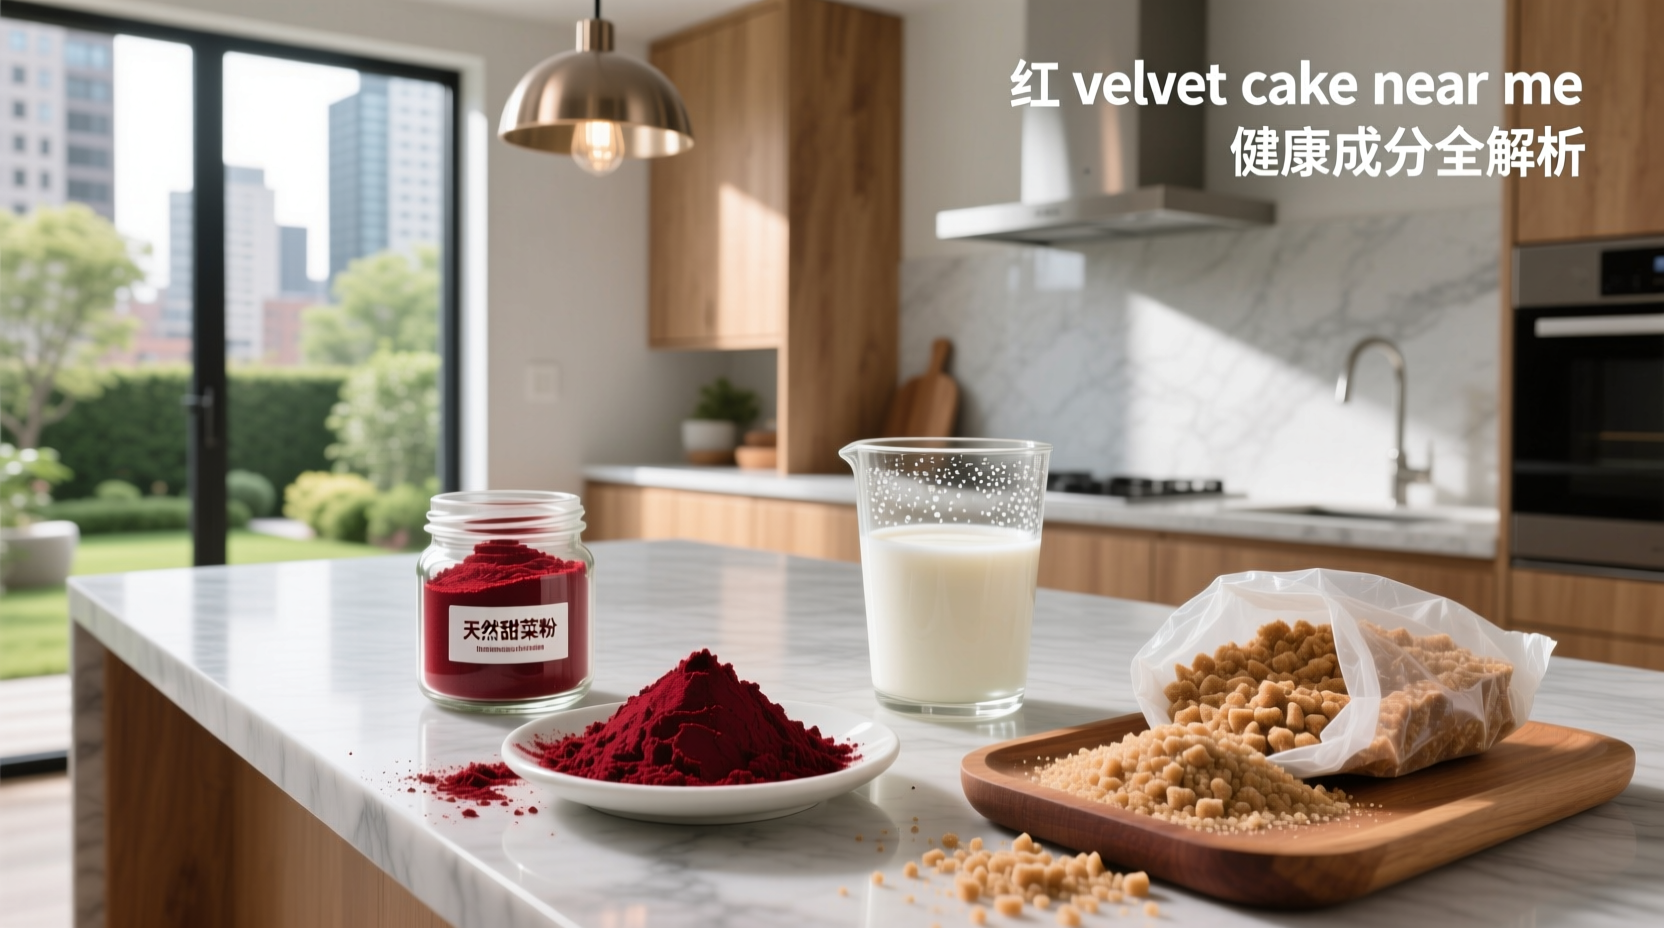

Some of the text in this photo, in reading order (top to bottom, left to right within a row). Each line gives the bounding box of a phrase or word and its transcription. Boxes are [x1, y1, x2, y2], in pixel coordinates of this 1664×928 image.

[463, 617, 557, 641] 天然甜菜粉
